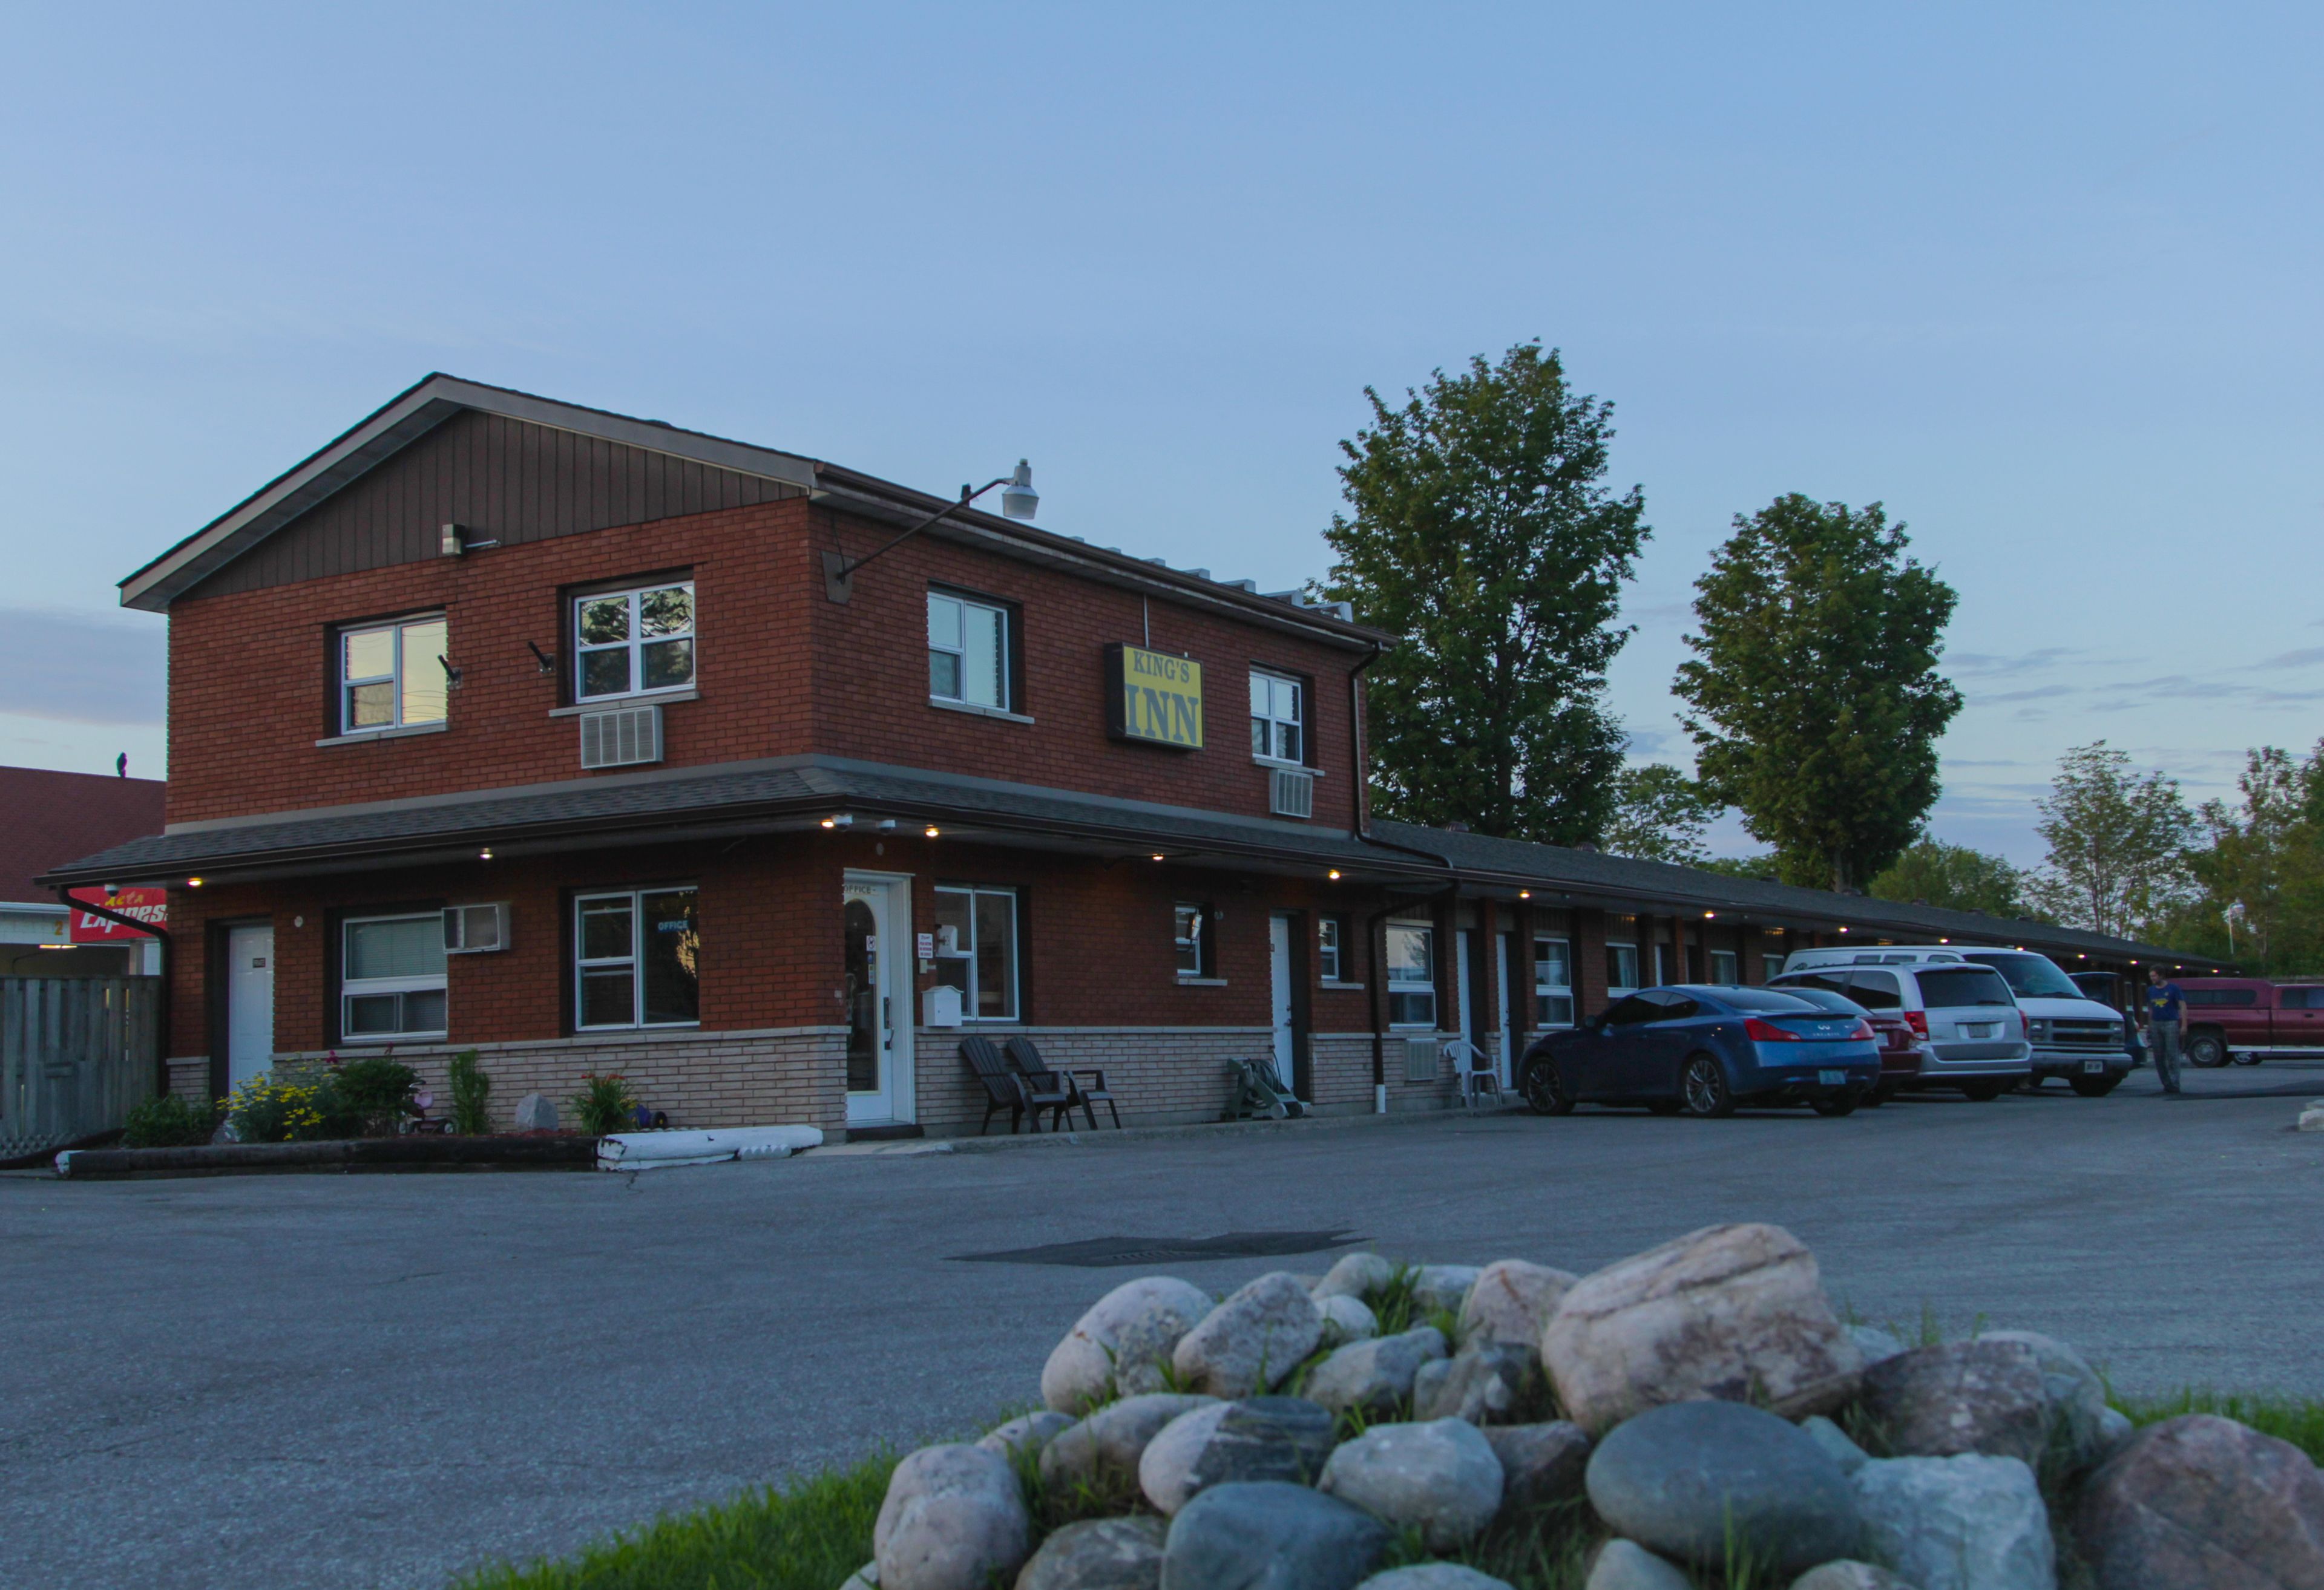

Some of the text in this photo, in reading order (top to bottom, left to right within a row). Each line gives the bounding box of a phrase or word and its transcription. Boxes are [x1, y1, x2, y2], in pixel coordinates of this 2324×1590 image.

[1133, 650, 1190, 683] KING'S
[1125, 684, 1198, 745] INN
[843, 885, 871, 894] OFFICE
[80, 903, 168, 933] Expres
